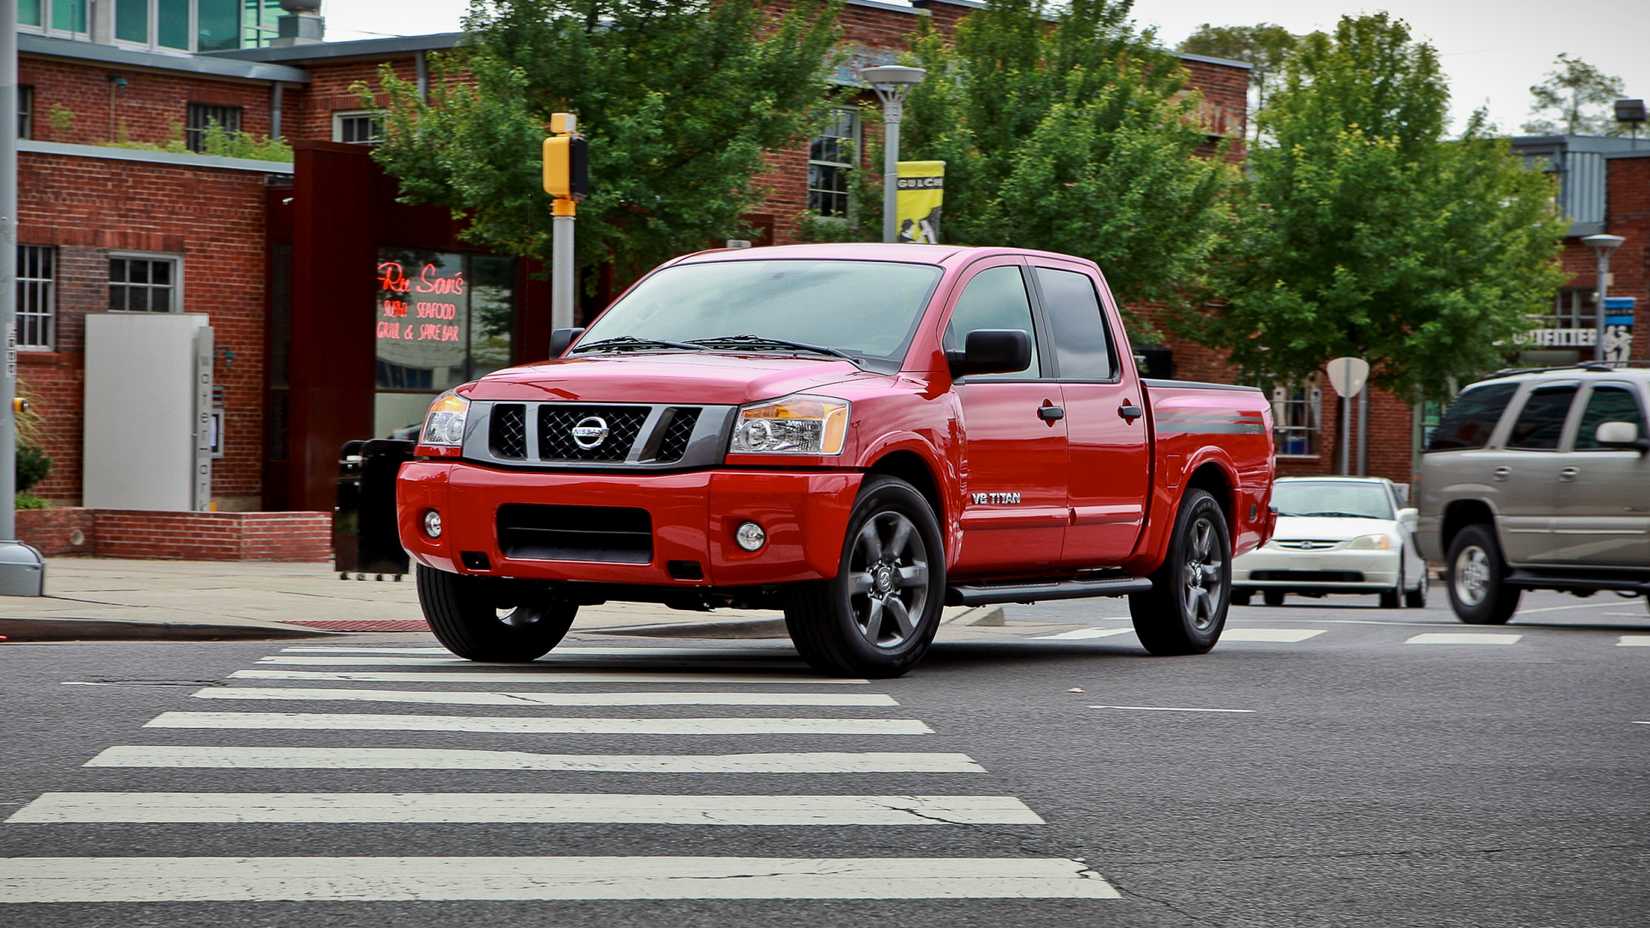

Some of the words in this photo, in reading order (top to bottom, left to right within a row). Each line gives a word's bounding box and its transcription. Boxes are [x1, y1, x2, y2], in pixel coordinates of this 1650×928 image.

[897, 178, 943, 188] GULCH
[416, 302, 456, 320] SEAFOOD
[404, 323, 414, 340] &
[989, 492, 1021, 504] TITAN
